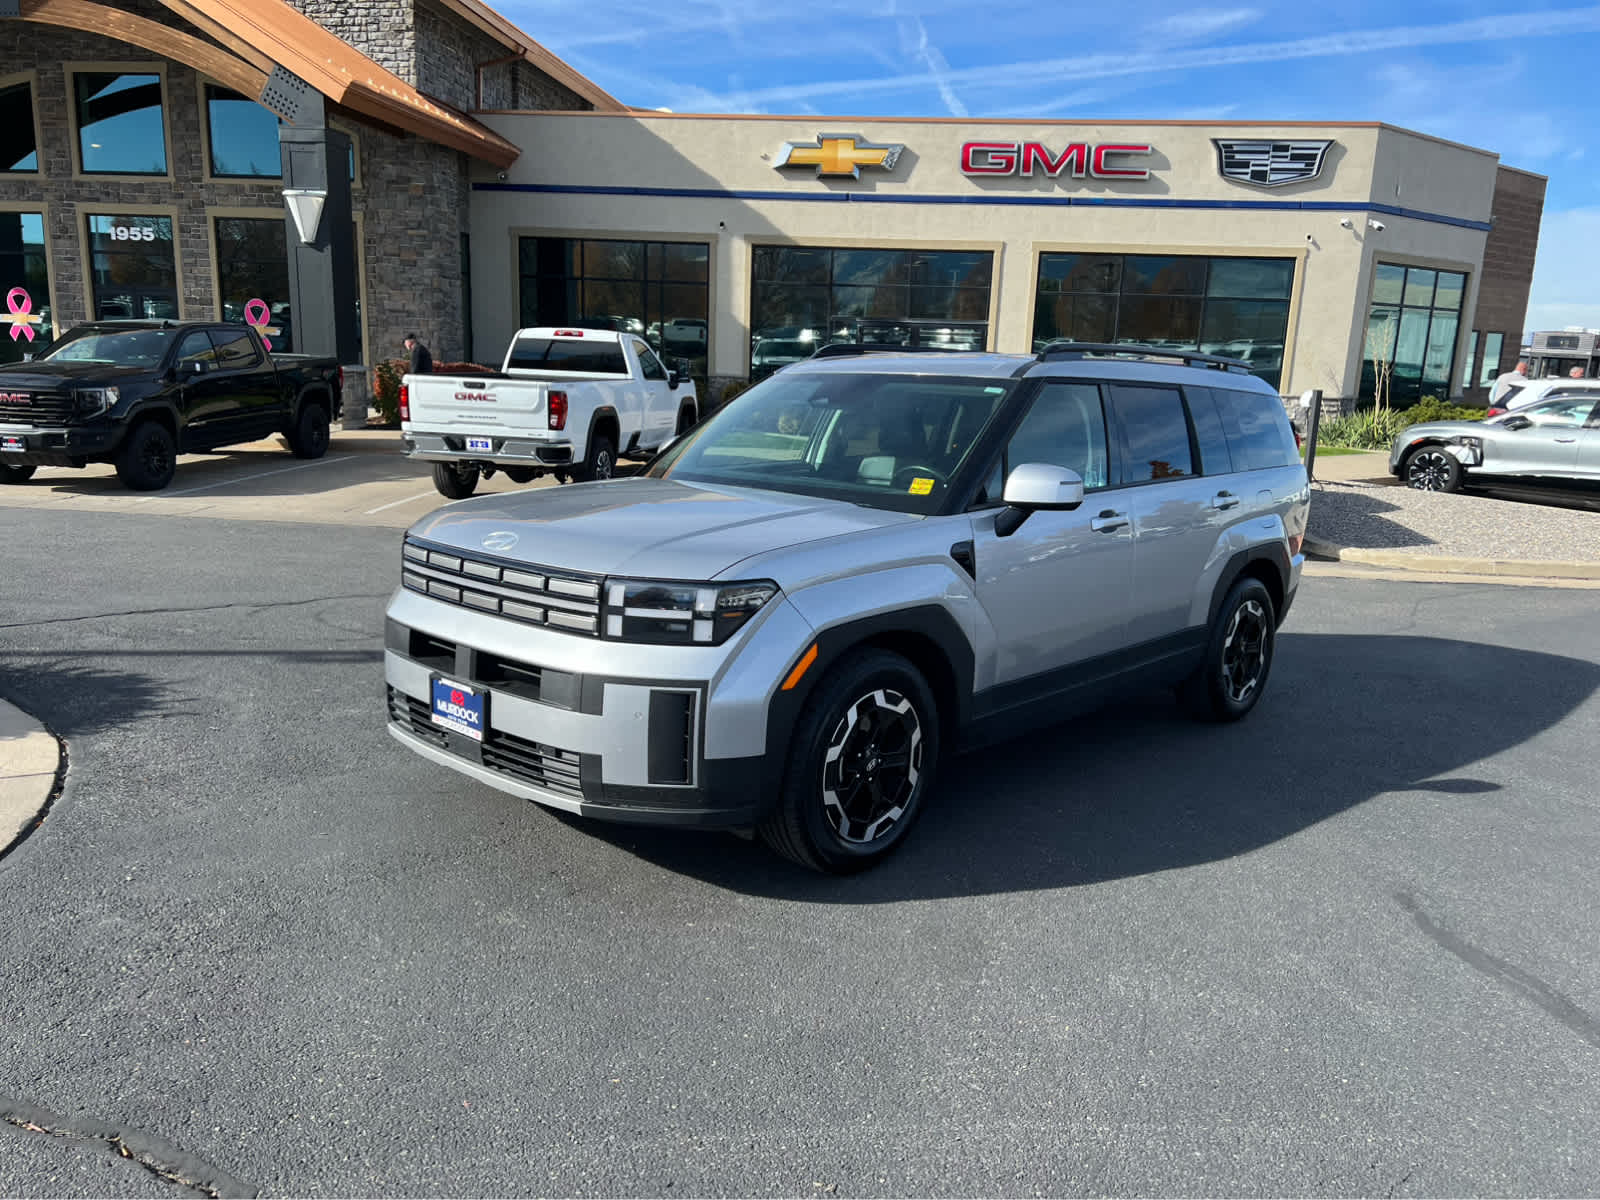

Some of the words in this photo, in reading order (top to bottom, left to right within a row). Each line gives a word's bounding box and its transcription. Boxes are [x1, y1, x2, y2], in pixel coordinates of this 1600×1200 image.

[960, 140, 1152, 181] GMC
[110, 226, 155, 241] 1955
[0, 393, 30, 402] MC
[454, 392, 497, 402] GMC
[436, 698, 479, 724] MURDOCK
